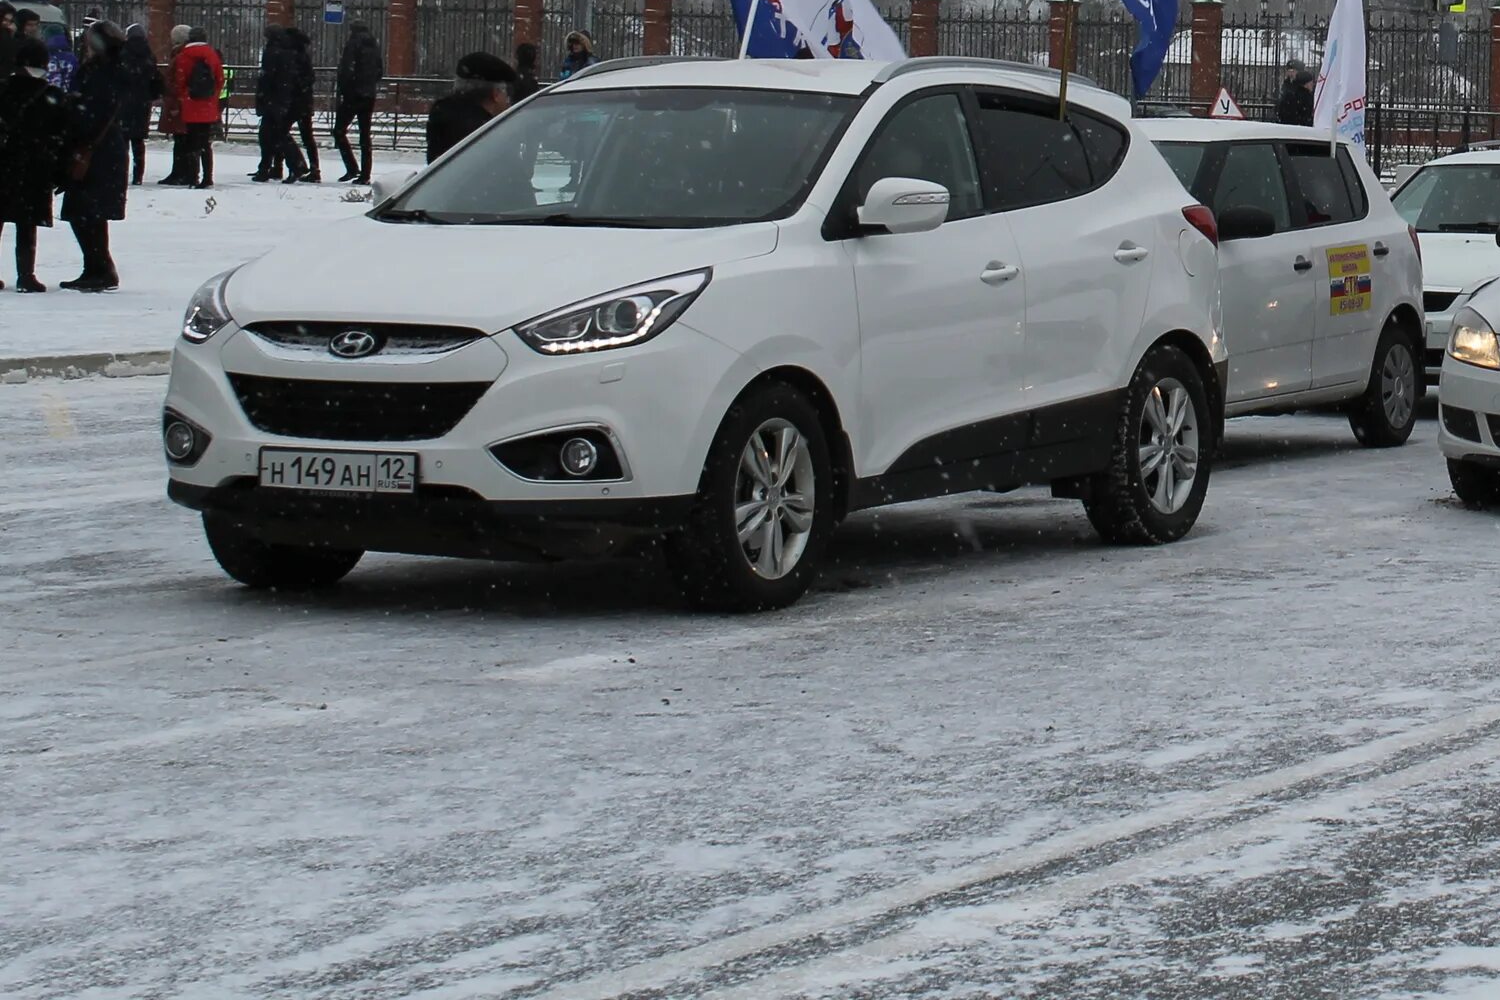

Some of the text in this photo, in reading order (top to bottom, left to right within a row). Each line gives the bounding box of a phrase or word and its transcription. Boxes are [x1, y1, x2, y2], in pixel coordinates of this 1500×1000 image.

[1220, 99, 1230, 115] У
[380, 458, 405, 480] 12
[377, 480, 397, 490] RUS
